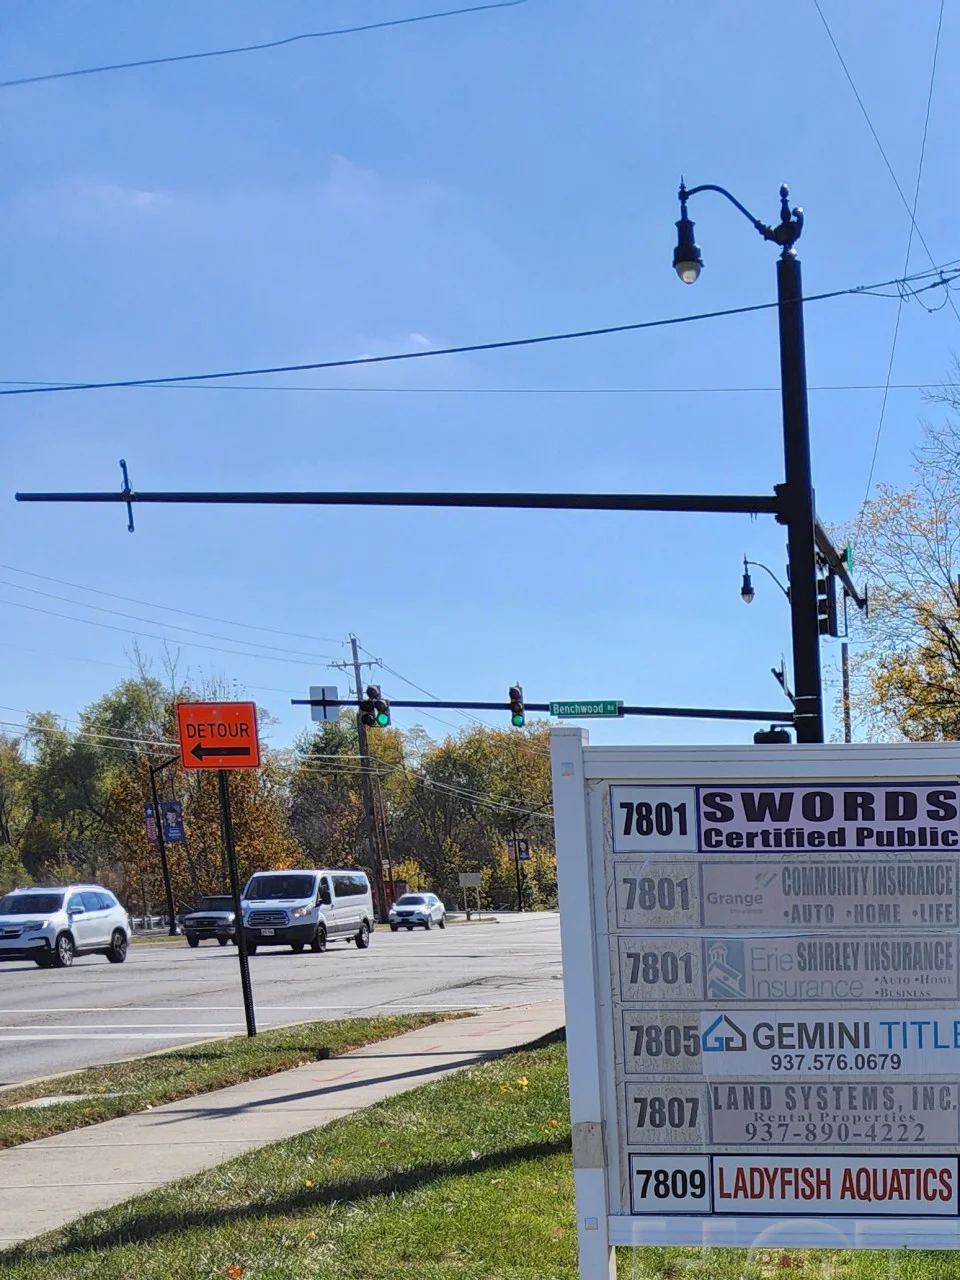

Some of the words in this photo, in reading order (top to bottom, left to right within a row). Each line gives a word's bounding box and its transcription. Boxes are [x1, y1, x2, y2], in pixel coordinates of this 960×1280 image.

[553, 703, 604, 714] Benchwood
[186, 723, 250, 738] DETOUR
[620, 802, 687, 836] 7801
[702, 790, 958, 823] SWORDS
[704, 827, 846, 848] Certified
[856, 827, 959, 847] Public
[623, 877, 690, 910] 7801
[782, 866, 870, 896] COMMUNITY
[872, 865, 953, 896] INSURANCE
[707, 891, 763, 907] Grange
[627, 952, 693, 984] 7801
[751, 947, 793, 971] Erie
[797, 942, 860, 971] SHIRLEY
[864, 941, 953, 971] INSURANCE
[752, 975, 864, 998] Insurance
[630, 1025, 700, 1057] 7805
[753, 1022, 870, 1050] GEMINI
[771, 1054, 902, 1071] 937.576.0679
[634, 1097, 700, 1128] 7807
[714, 1086, 772, 1110] LAND
[785, 1086, 903, 1112] SYSTEMS,
[913, 1086, 957, 1110] INC.
[745, 1122, 926, 1142] 937-890-4222
[754, 1112, 813, 1123] Rental
[820, 1112, 916, 1125] Properties
[636, 1169, 706, 1199] 7809
[718, 1167, 831, 1200] LADYFISH
[840, 1167, 953, 1203] AQUATICS
